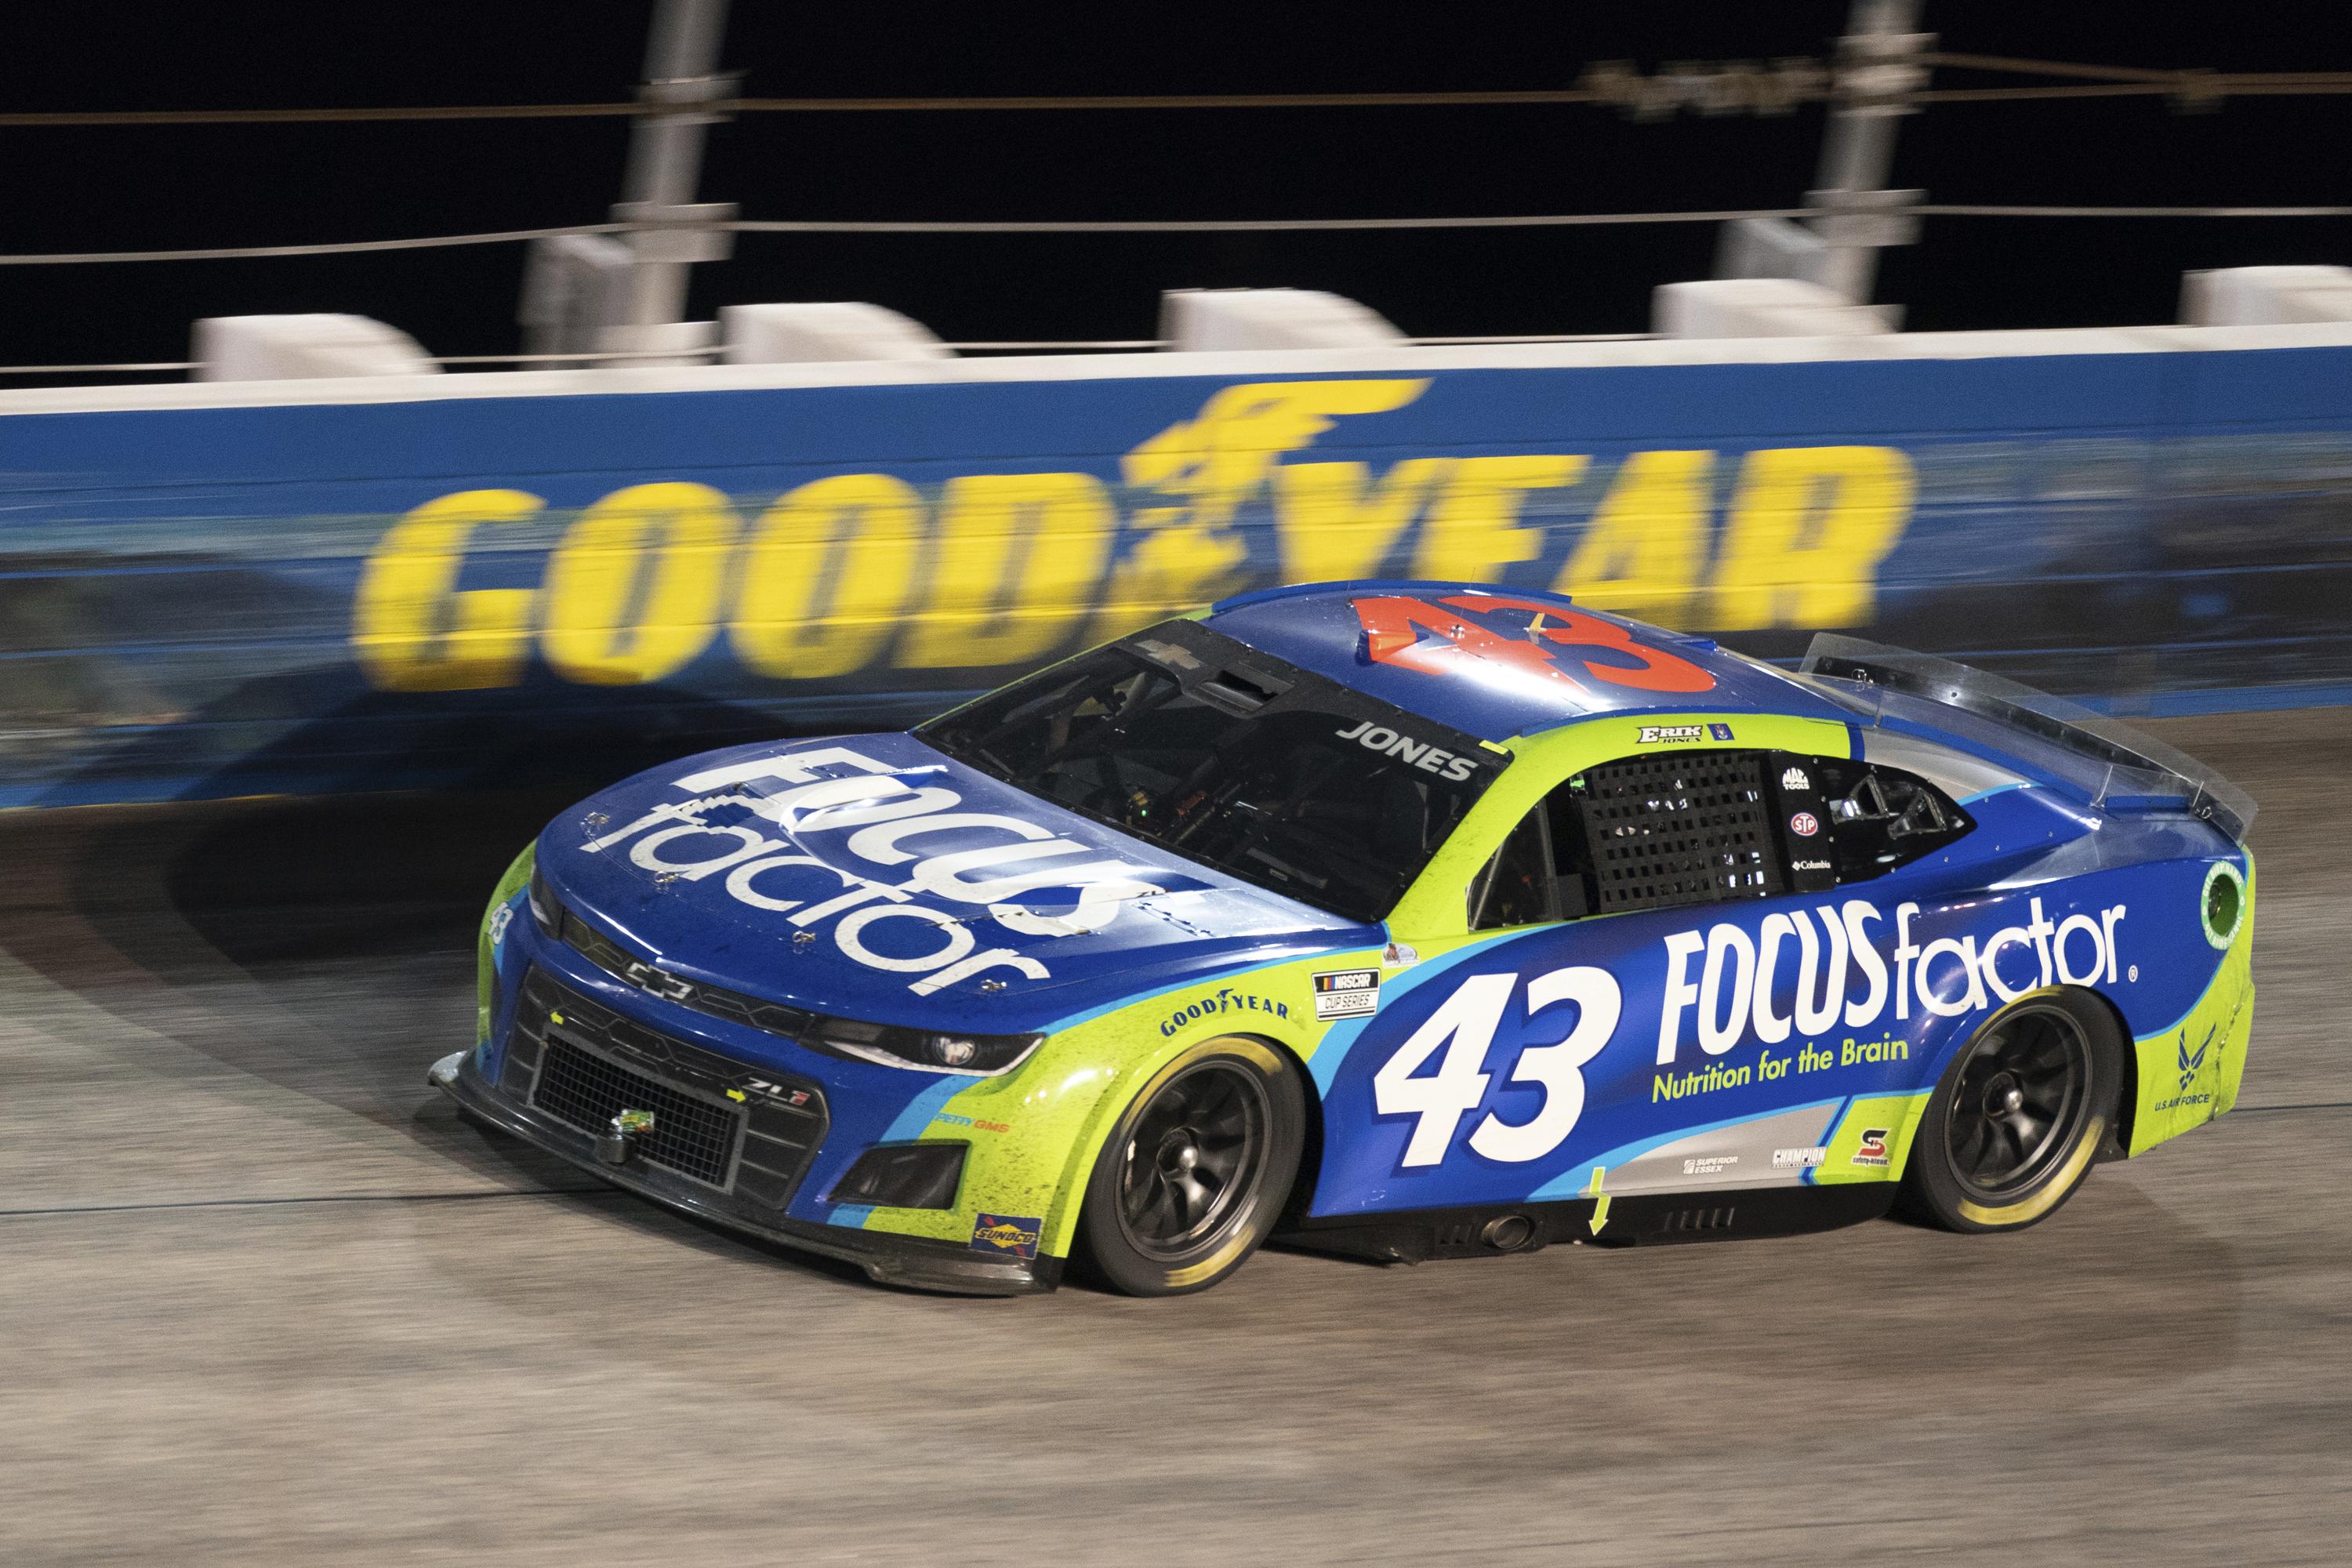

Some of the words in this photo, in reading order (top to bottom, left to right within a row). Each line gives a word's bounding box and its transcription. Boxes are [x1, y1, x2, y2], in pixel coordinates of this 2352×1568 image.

[353, 445, 1918, 691] GOODYEAR
[1351, 596, 1717, 695] 43
[1638, 726, 1702, 743] ERIK
[1335, 721, 1479, 781] JONES
[1783, 768, 1809, 784] MAC
[1795, 815, 1815, 833] STP
[669, 746, 1166, 937] FOCUS
[1800, 860, 1831, 869] Columbia
[579, 786, 1051, 996] factor
[488, 902, 514, 945] 43
[1334, 973, 1371, 989] NASCAR
[1655, 899, 1889, 1066] FOCUS
[1325, 996, 1341, 1009] CUP
[1342, 994, 1370, 1007] SERIES
[1160, 991, 1288, 1037] GOODYEAR
[1374, 966, 1622, 1167] 43
[1652, 1062, 1751, 1103] Nutrition
[1759, 1050, 1791, 1082] for
[1798, 1042, 1833, 1073] the
[1841, 1032, 1908, 1066] Brain
[2168, 1098, 2179, 1108] AIR
[2180, 1094, 2210, 1105] FORCE
[974, 1120, 1010, 1133] GMS
[1697, 1156, 1738, 1166] SUPERIOR
[1773, 1148, 1827, 1164] CHAMPION
[1694, 1165, 1723, 1174] ESSEX
[977, 1229, 1036, 1243] SUNOCO
